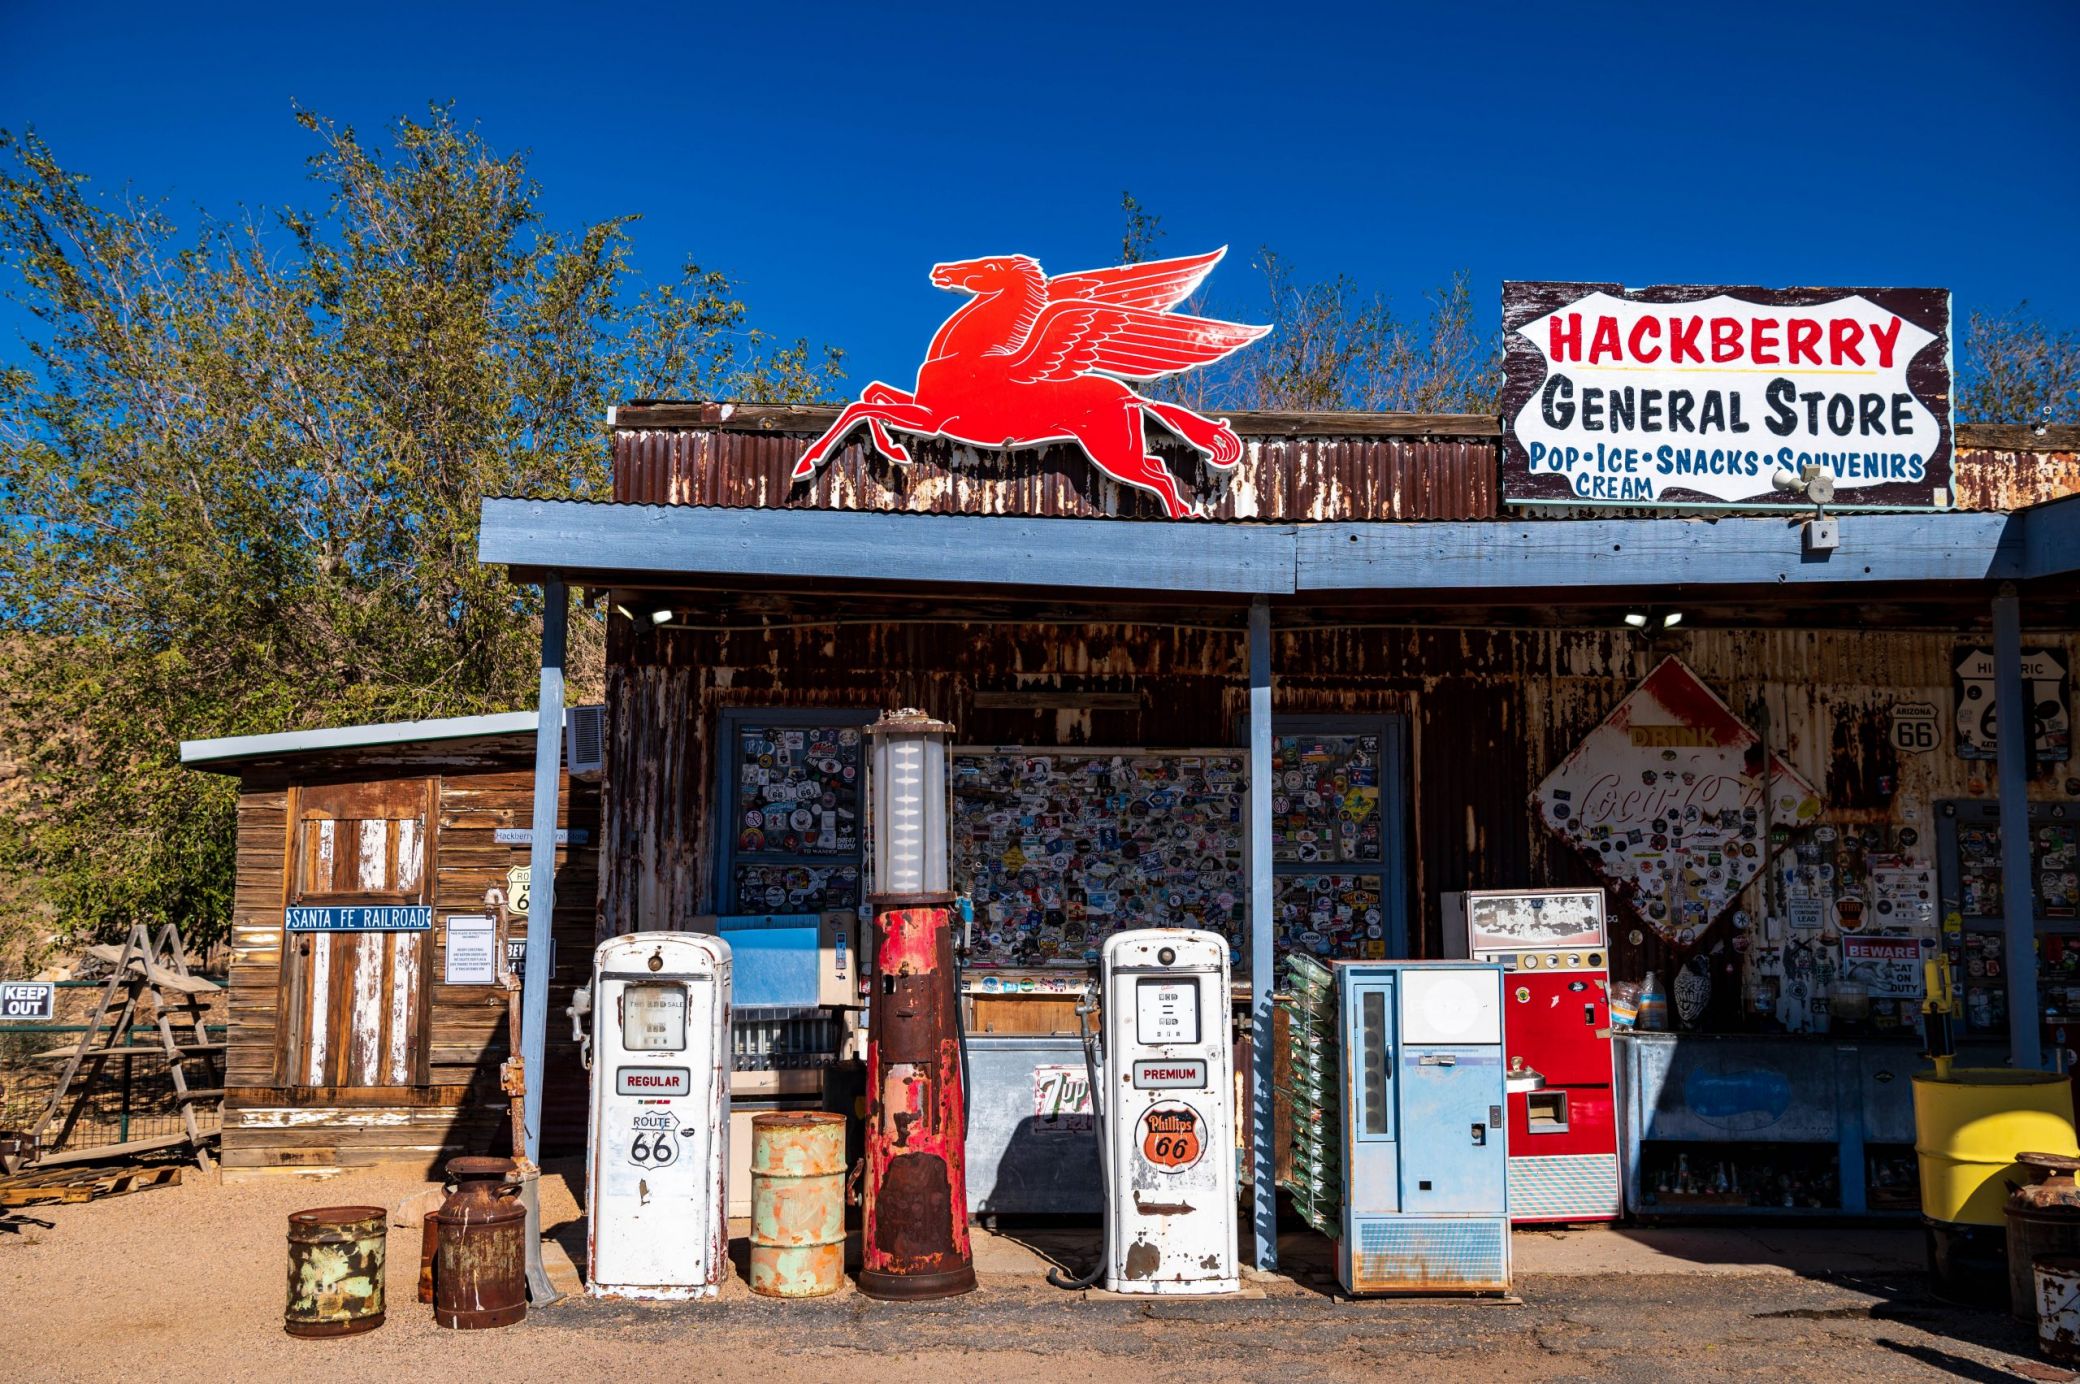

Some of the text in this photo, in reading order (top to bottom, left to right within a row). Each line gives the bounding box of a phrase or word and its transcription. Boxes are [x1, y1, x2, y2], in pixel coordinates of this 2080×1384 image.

[1549, 312, 1903, 369] HACKBERRY
[1541, 373, 1915, 436] GENERAL STORE
[1576, 472, 1654, 499] CREAM
[1977, 663, 2044, 674] HIRIC
[1896, 708, 1931, 716] ARIZONA
[1632, 726, 1721, 747] DRINK
[1897, 722, 1932, 747] 66
[292, 909, 425, 928] SANTA FE RAILROAD
[1850, 945, 1916, 958] BEWARE
[1894, 964, 1913, 972] CAT
[1897, 974, 1911, 982] ON
[4, 986, 48, 1000] KEEP
[1891, 984, 1918, 992] DUTY
[8, 1001, 42, 1015] OUT
[1144, 1069, 1196, 1079] PREMIUM
[627, 1076, 680, 1087] REGULAR
[633, 1116, 671, 1128] ROUTE
[1149, 1115, 1192, 1131] Phillips
[631, 1132, 672, 1162] 66
[1156, 1137, 1188, 1159] 66
